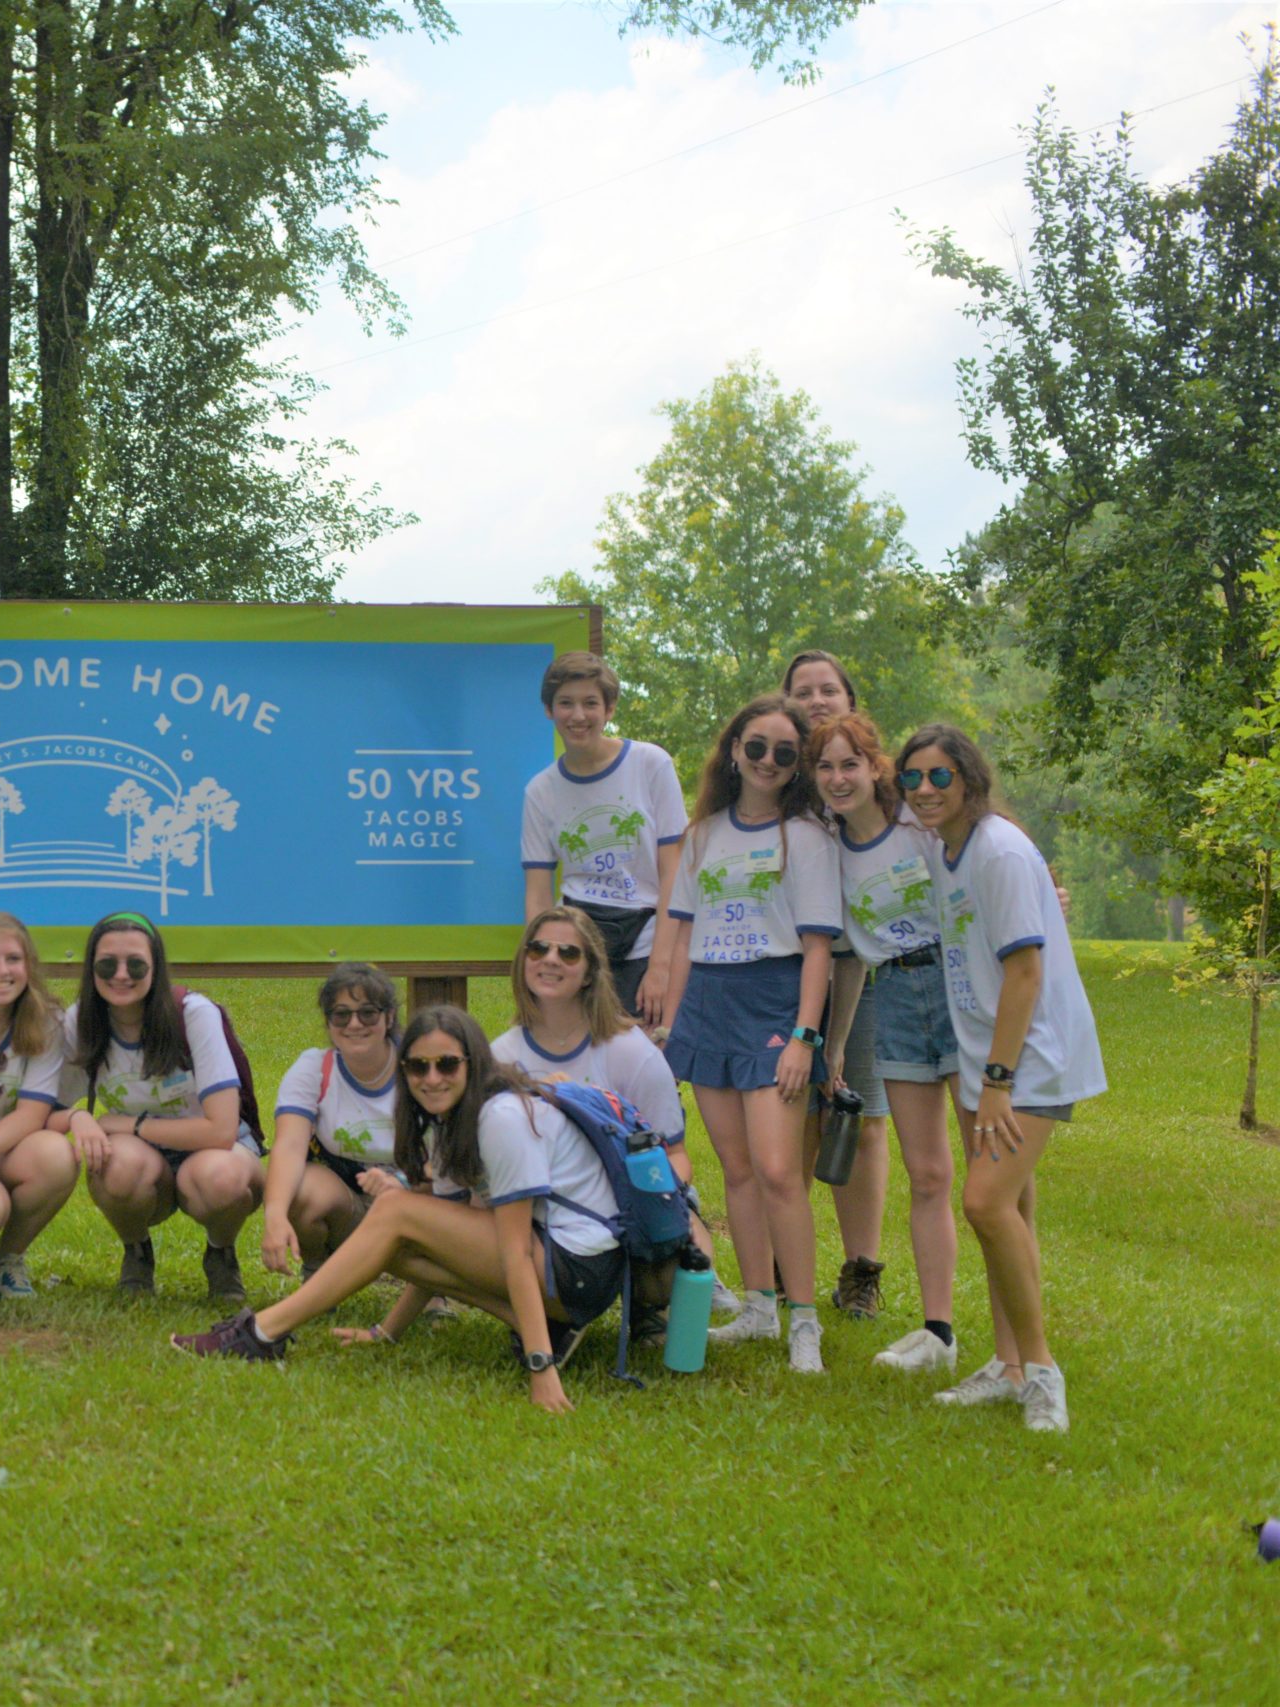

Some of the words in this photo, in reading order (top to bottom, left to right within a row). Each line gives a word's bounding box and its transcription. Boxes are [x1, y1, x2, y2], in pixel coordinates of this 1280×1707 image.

[132, 664, 280, 734] HOME
[22, 748, 35, 758] S.
[44, 745, 107, 759] JACOBS
[114, 753, 161, 777] CAMP
[348, 768, 391, 799] 50
[407, 768, 481, 799] YRS
[363, 810, 463, 826] JACOBS
[368, 832, 457, 847] MAGIC
[594, 852, 615, 872] 50
[725, 903, 744, 922] 50
[889, 920, 915, 940] 50
[703, 933, 769, 948] JACOBS
[704, 948, 765, 961] MAGIC
